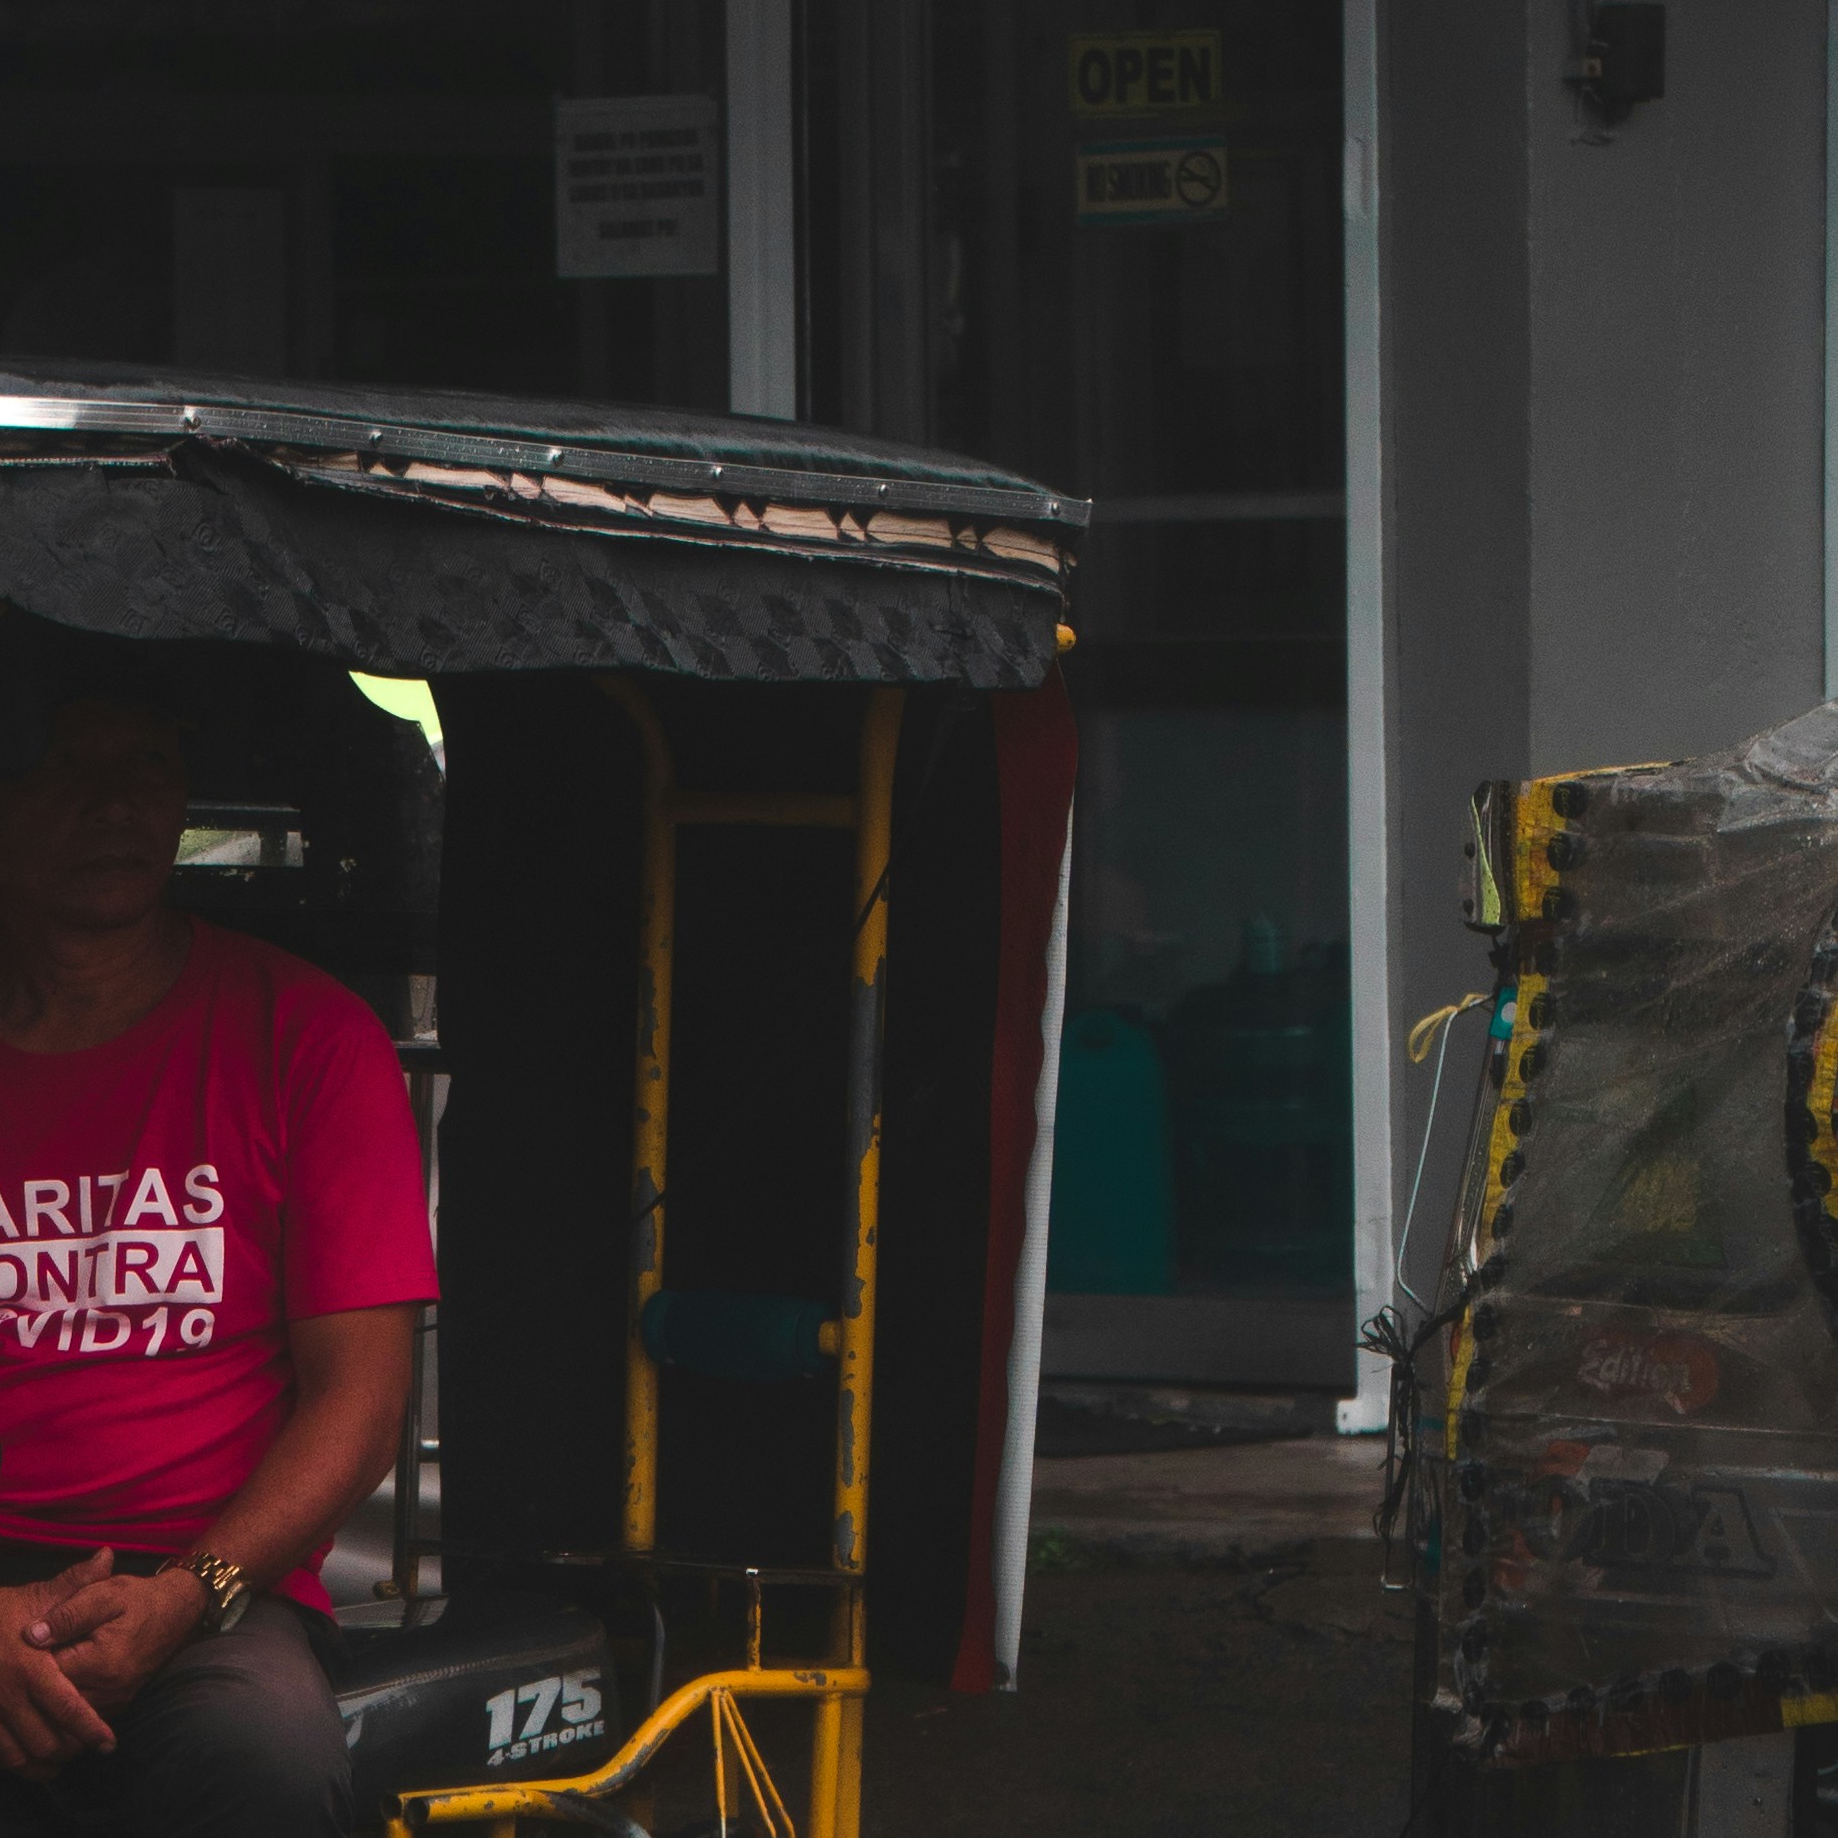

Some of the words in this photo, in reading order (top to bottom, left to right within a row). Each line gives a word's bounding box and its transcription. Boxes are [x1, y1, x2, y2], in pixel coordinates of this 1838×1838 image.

[1078, 46, 1212, 105] OPEN
[485, 1666, 602, 1751] 175
[486, 1720, 605, 1767] 4-STROKE
